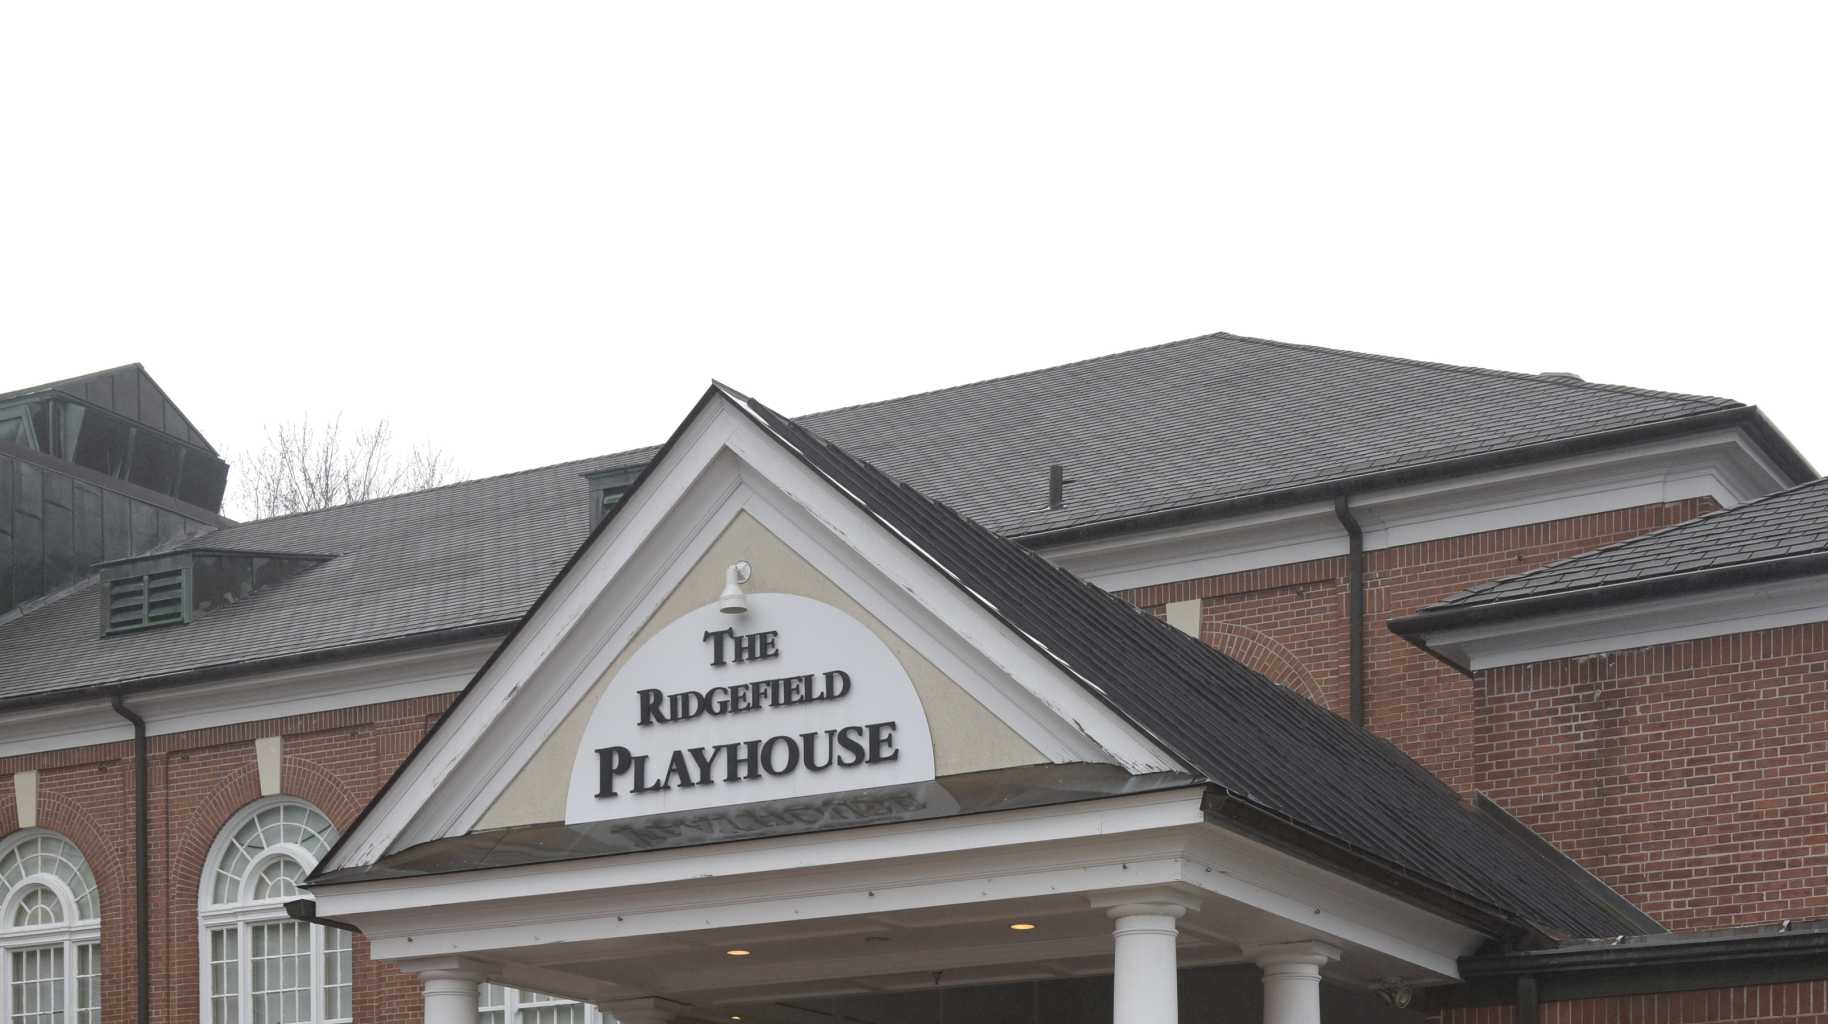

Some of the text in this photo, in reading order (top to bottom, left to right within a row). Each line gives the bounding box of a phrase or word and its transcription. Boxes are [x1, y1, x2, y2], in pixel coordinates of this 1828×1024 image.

[703, 627, 779, 666] THE
[637, 669, 851, 726] RIDGEFIELD
[594, 720, 899, 799] PLAYHOUSE
